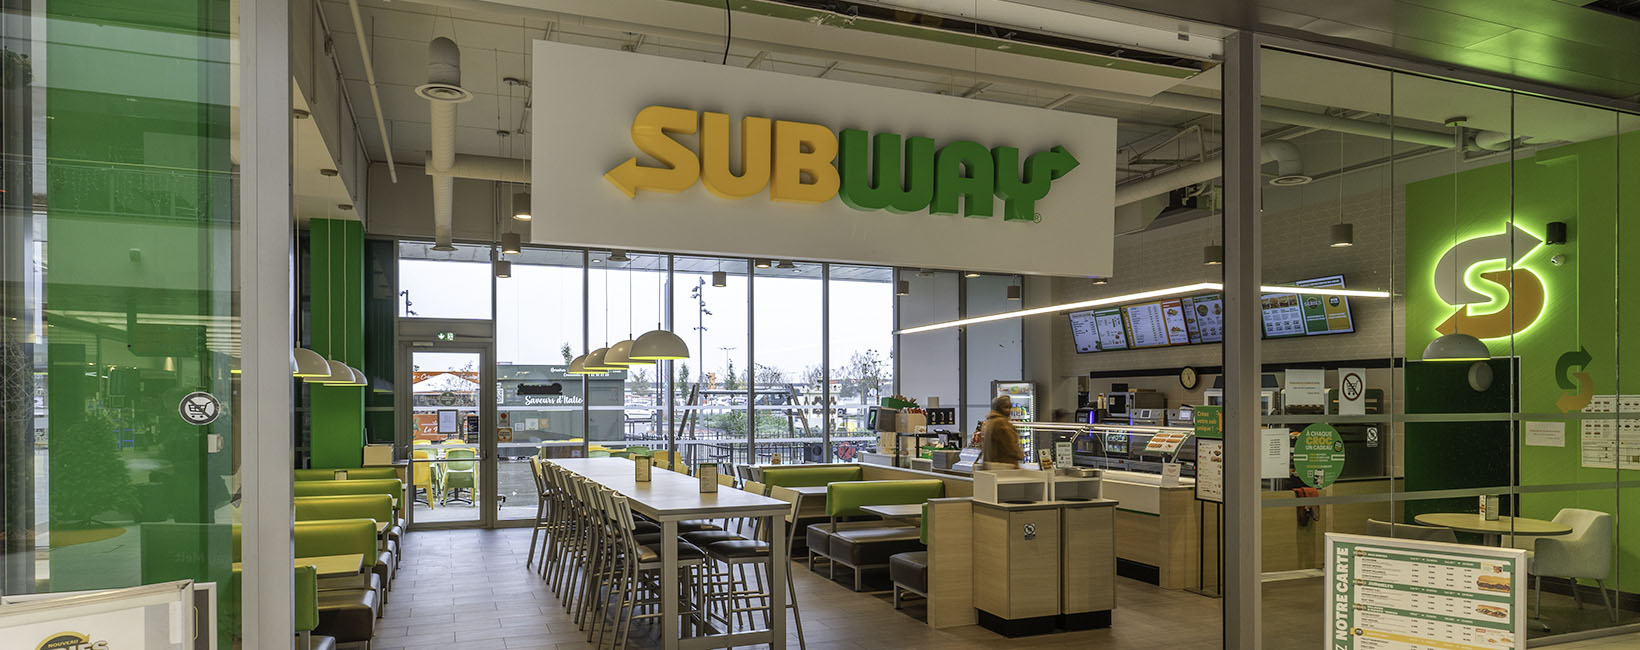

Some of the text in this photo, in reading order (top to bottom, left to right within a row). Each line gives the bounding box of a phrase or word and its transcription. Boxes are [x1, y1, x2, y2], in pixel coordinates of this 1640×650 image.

[604, 105, 1080, 222] SUBWAY
[525, 395, 584, 406] Saveurs d'Italie
[1305, 436, 1333, 445] CROC
[1335, 547, 1349, 593] CARTE
[1335, 594, 1348, 641] NOTRE
[48, 640, 79, 649] NOUVEAU
